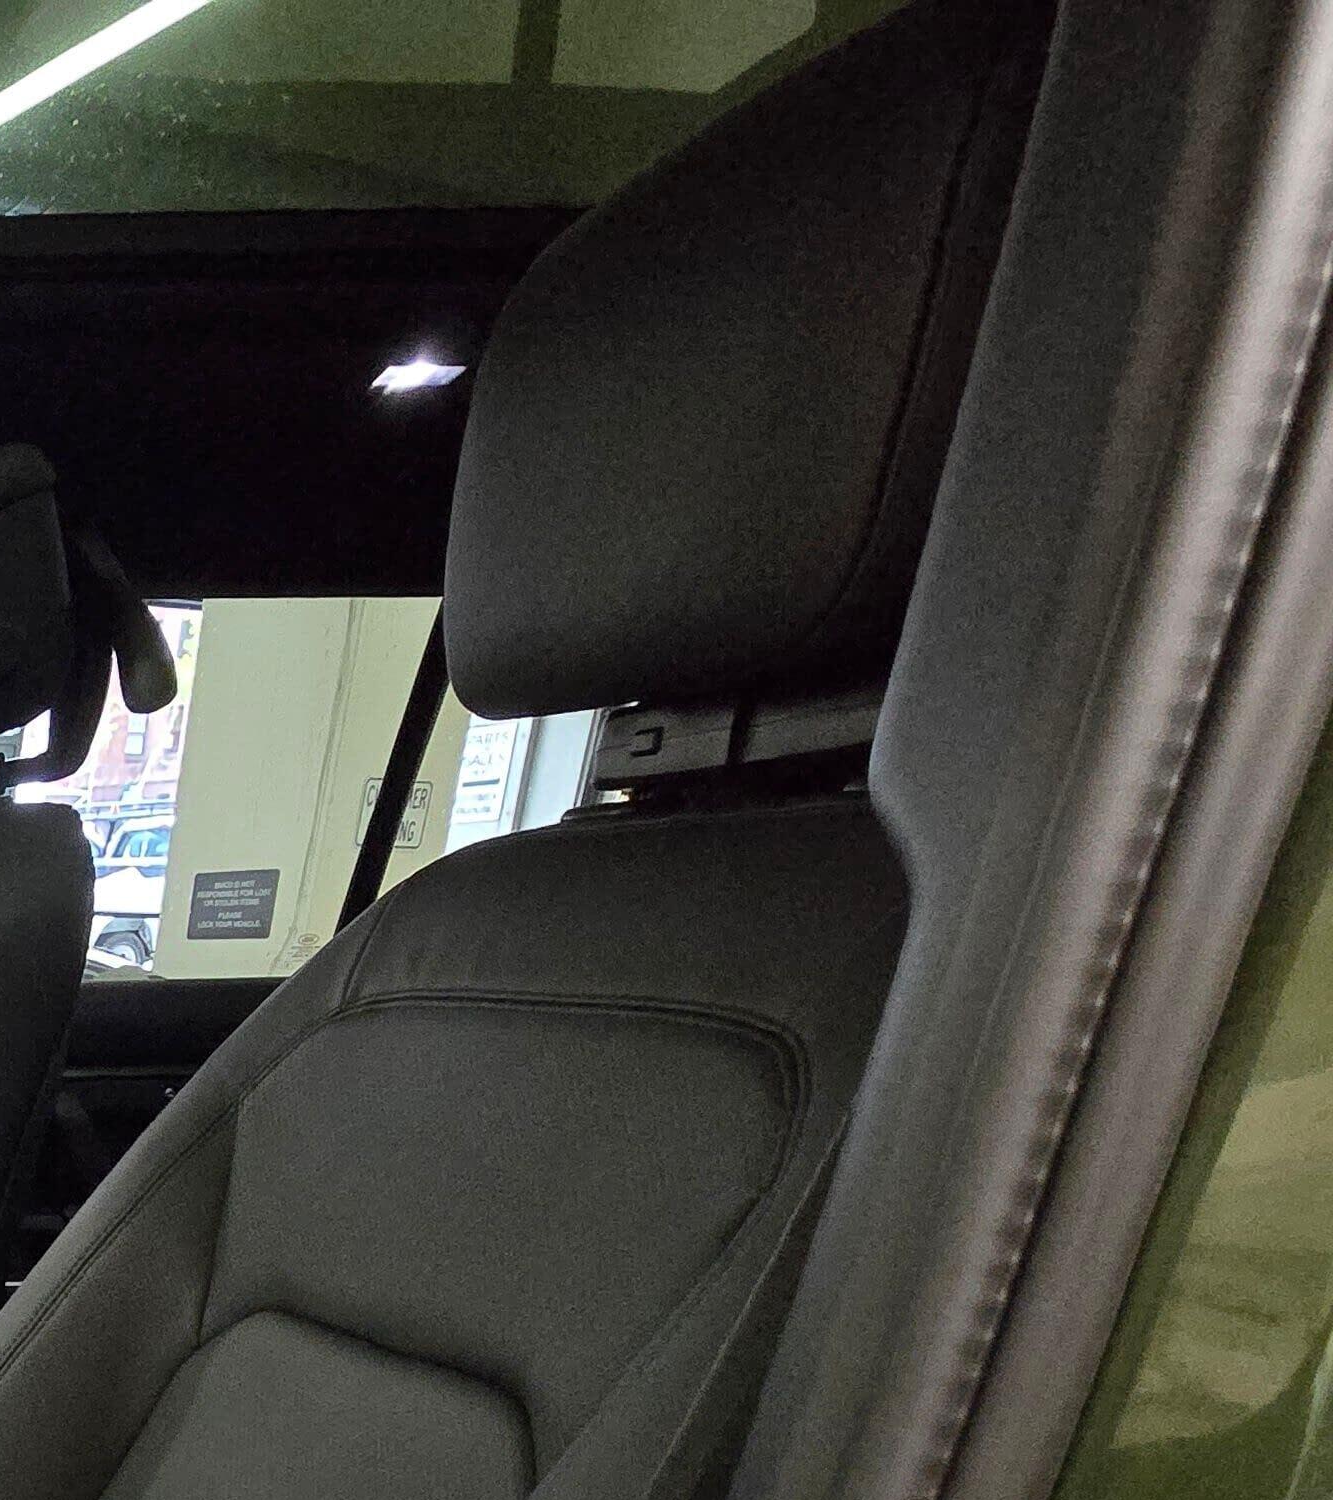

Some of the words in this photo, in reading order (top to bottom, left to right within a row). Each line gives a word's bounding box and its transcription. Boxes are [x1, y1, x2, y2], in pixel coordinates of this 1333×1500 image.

[239, 889, 254, 897] FOR
[254, 888, 272, 896] LOST
[218, 911, 242, 920] PLEASE
[197, 920, 213, 928] LOCK
[215, 920, 233, 928] YOUR
